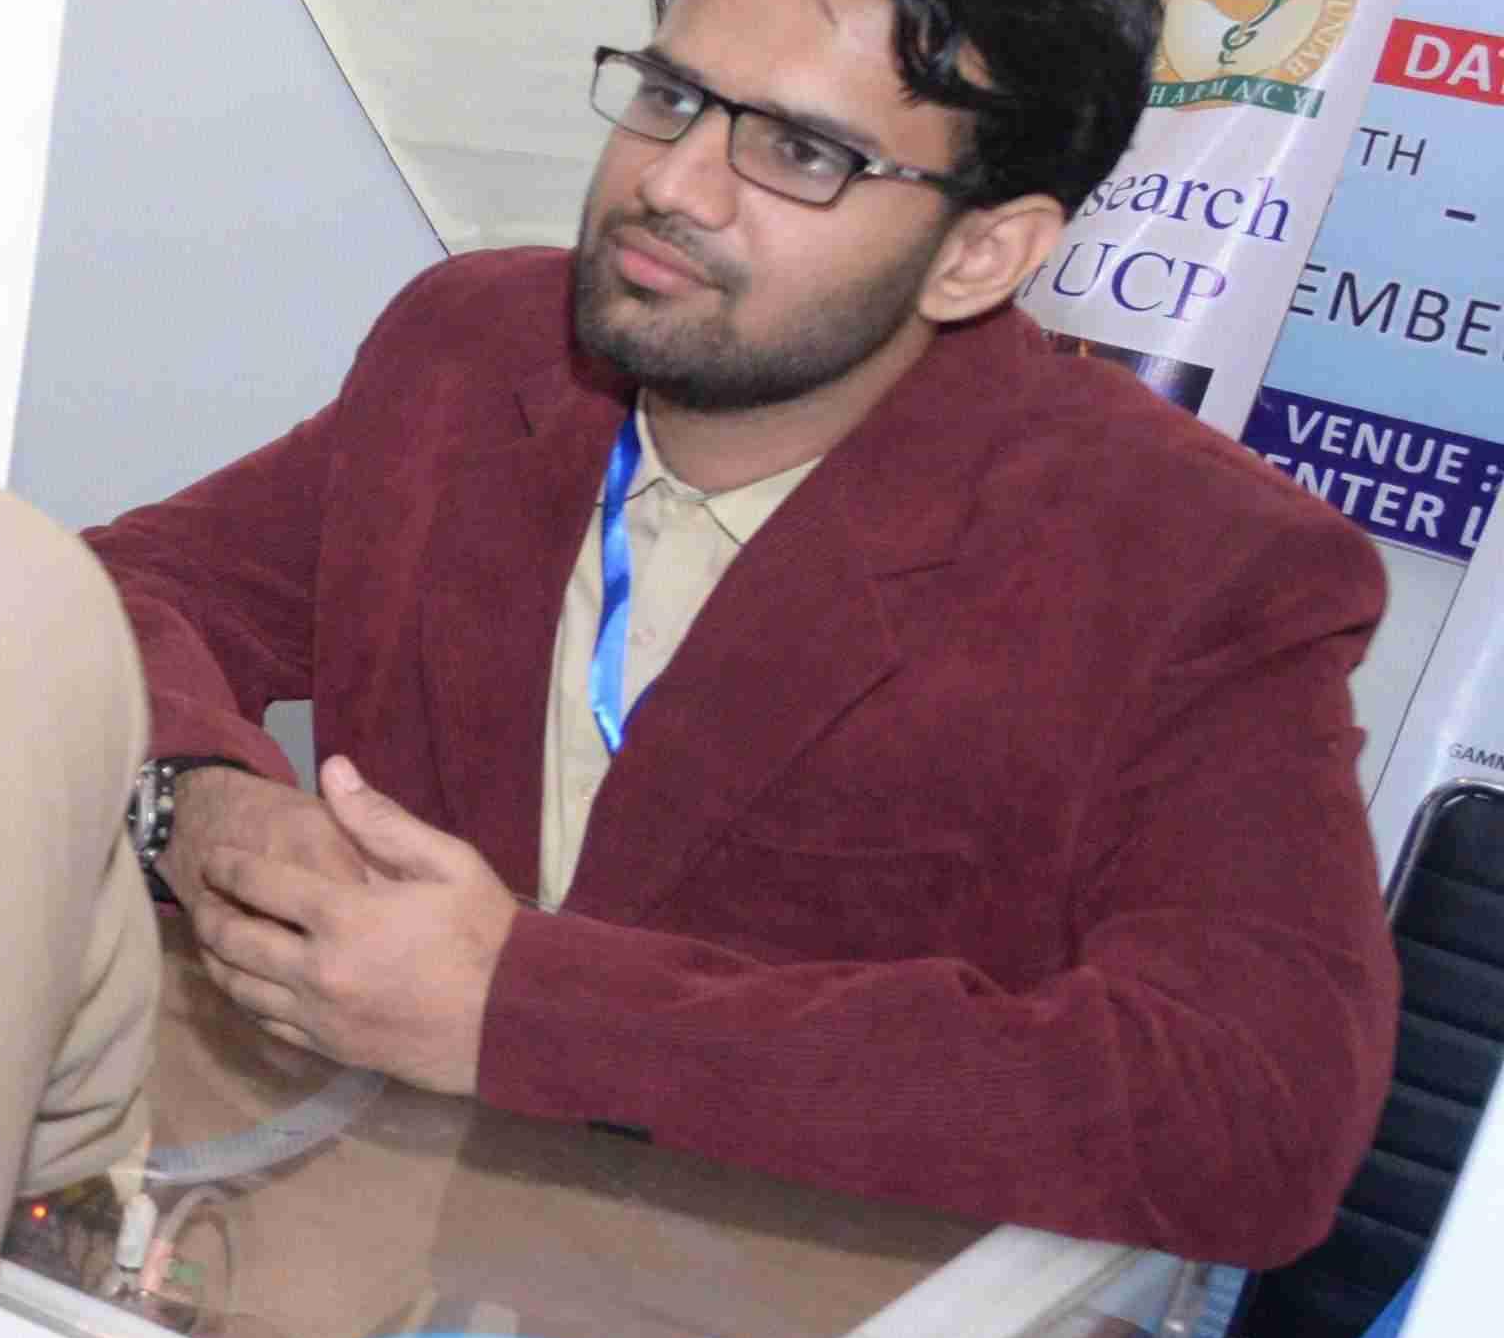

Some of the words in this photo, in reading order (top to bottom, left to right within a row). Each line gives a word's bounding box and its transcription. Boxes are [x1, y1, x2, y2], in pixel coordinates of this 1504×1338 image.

[1149, 78, 1322, 115] HARMACY
[1403, 33, 1504, 95] DA
[1359, 127, 1427, 177] TH
[1081, 171, 1292, 243] search
[1051, 242, 1228, 323] UCP
[1288, 263, 1504, 357] EMBE
[1287, 404, 1471, 485] VENUE
[1265, 452, 1446, 539] NTER
